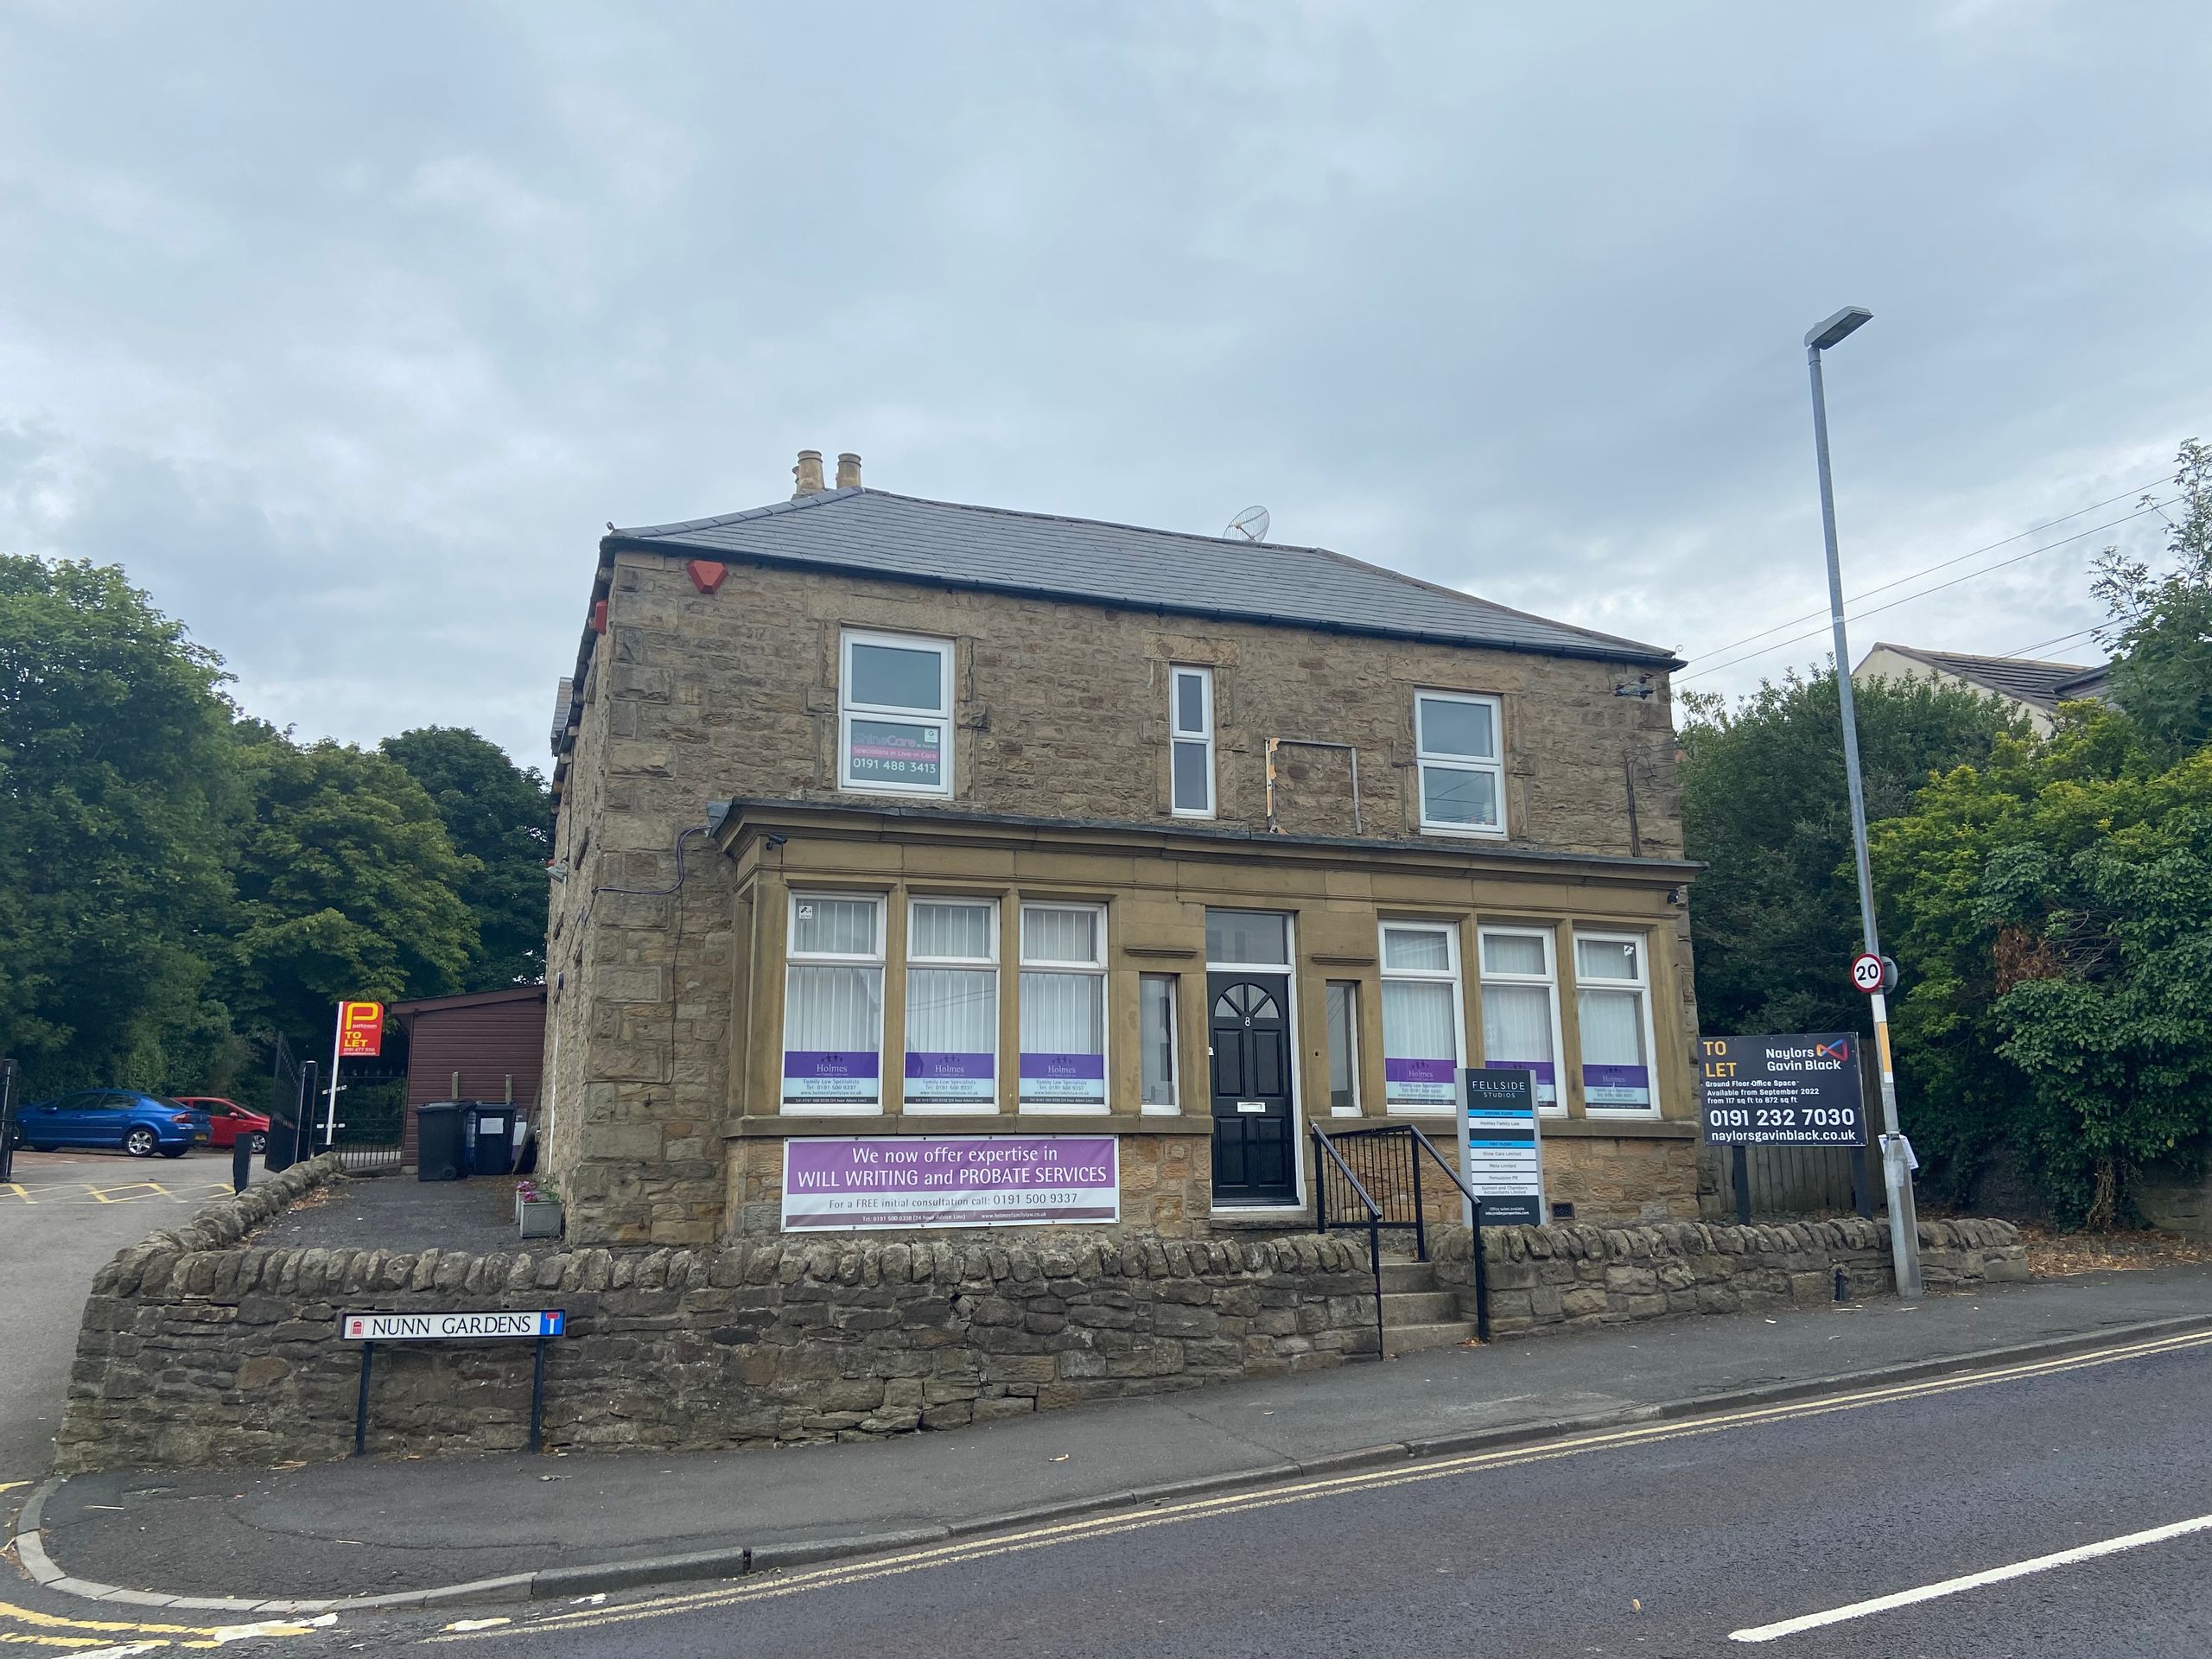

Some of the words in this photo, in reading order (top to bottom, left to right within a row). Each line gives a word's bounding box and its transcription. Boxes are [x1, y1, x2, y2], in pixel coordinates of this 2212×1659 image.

[854, 747, 889, 756] Specialists
[853, 758, 879, 769] 0191
[883, 760, 906, 772] 488
[910, 762, 936, 773] 3413
[1856, 963, 1878, 982] 20
[1244, 1016, 1250, 1027] 8
[345, 1031, 362, 1039] TO
[1703, 1040, 1726, 1056] TO
[1765, 1047, 1815, 1059] Naylors
[817, 1064, 848, 1072] Holmes
[935, 1065, 964, 1073] Holmes
[1705, 1062, 1737, 1077] LET
[1767, 1060, 1802, 1071] Gavin
[1805, 1059, 1841, 1071] Black
[1472, 1080, 1525, 1090] FELLSIDE
[1709, 1109, 1749, 1127] 0191
[1756, 1109, 1796, 1126] 232
[1802, 1109, 1855, 1126] 7030
[1711, 1129, 1856, 1142] naylorsgavinblack.co.uk
[852, 1147, 879, 1164] We
[885, 1151, 918, 1163] now
[924, 1147, 963, 1163] offer
[968, 1146, 1039, 1166] expertise
[1044, 1146, 1058, 1160] in
[798, 1171, 841, 1188] WILL
[845, 1169, 918, 1186] WRITING
[924, 1169, 954, 1185] and
[959, 1168, 1030, 1185] PROBATE
[1035, 1166, 1107, 1183] SERVICES
[830, 1199, 843, 1210] For
[856, 1198, 879, 1208] FREE
[881, 1198, 908, 1207] initial
[912, 1197, 969, 1207] consultation
[971, 1197, 990, 1205] call:
[994, 1194, 1020, 1205] 0191
[1026, 1194, 1046, 1204] 500
[1050, 1193, 1077, 1204] 9337
[372, 1318, 430, 1336] NUNN
[442, 1315, 531, 1334] GARDENS
